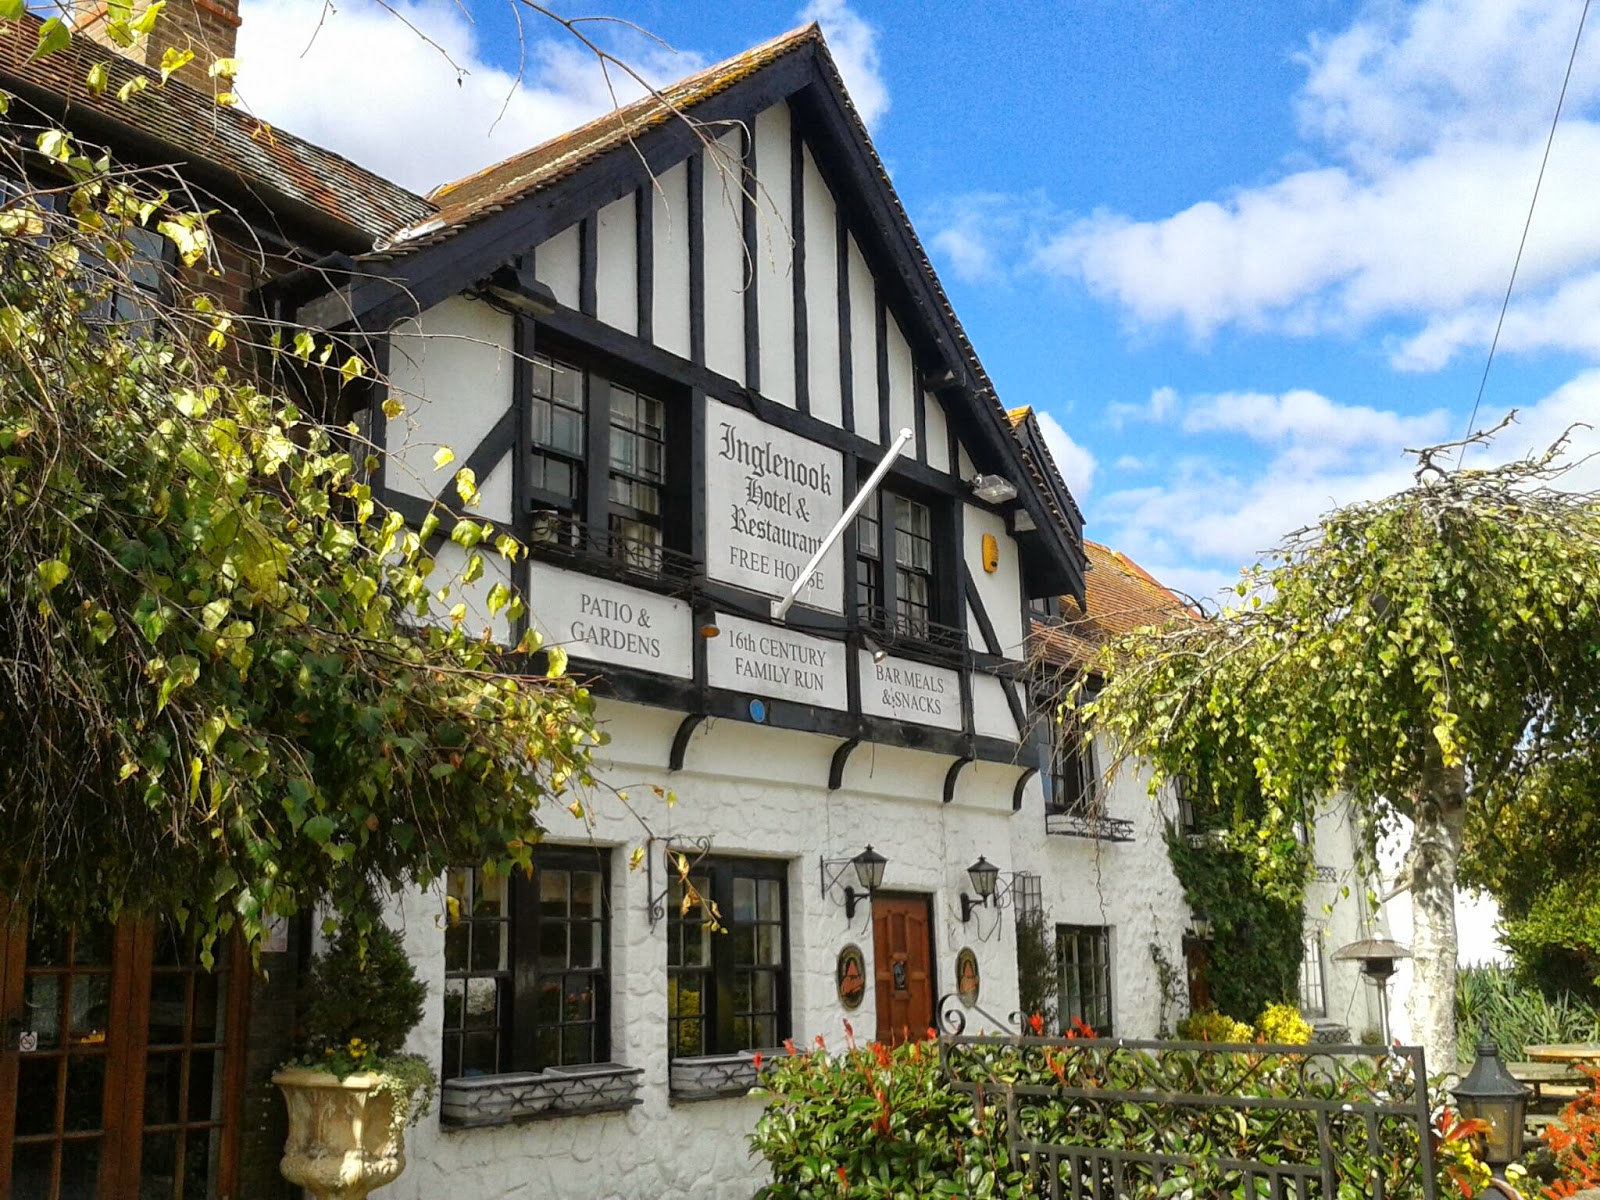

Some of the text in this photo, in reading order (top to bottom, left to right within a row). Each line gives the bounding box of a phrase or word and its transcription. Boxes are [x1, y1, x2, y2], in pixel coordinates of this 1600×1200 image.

[719, 422, 832, 496] Inglenook
[745, 476, 811, 522] Hotel &
[729, 546, 770, 575] FREE
[580, 594, 651, 628] PATIO &
[570, 621, 661, 659] GARDENS
[729, 630, 827, 668] 16th CENTURY
[734, 657, 824, 692] FAMILY RUN
[875, 664, 944, 694] BAR MEALS
[881, 688, 942, 716] & SNACKS
